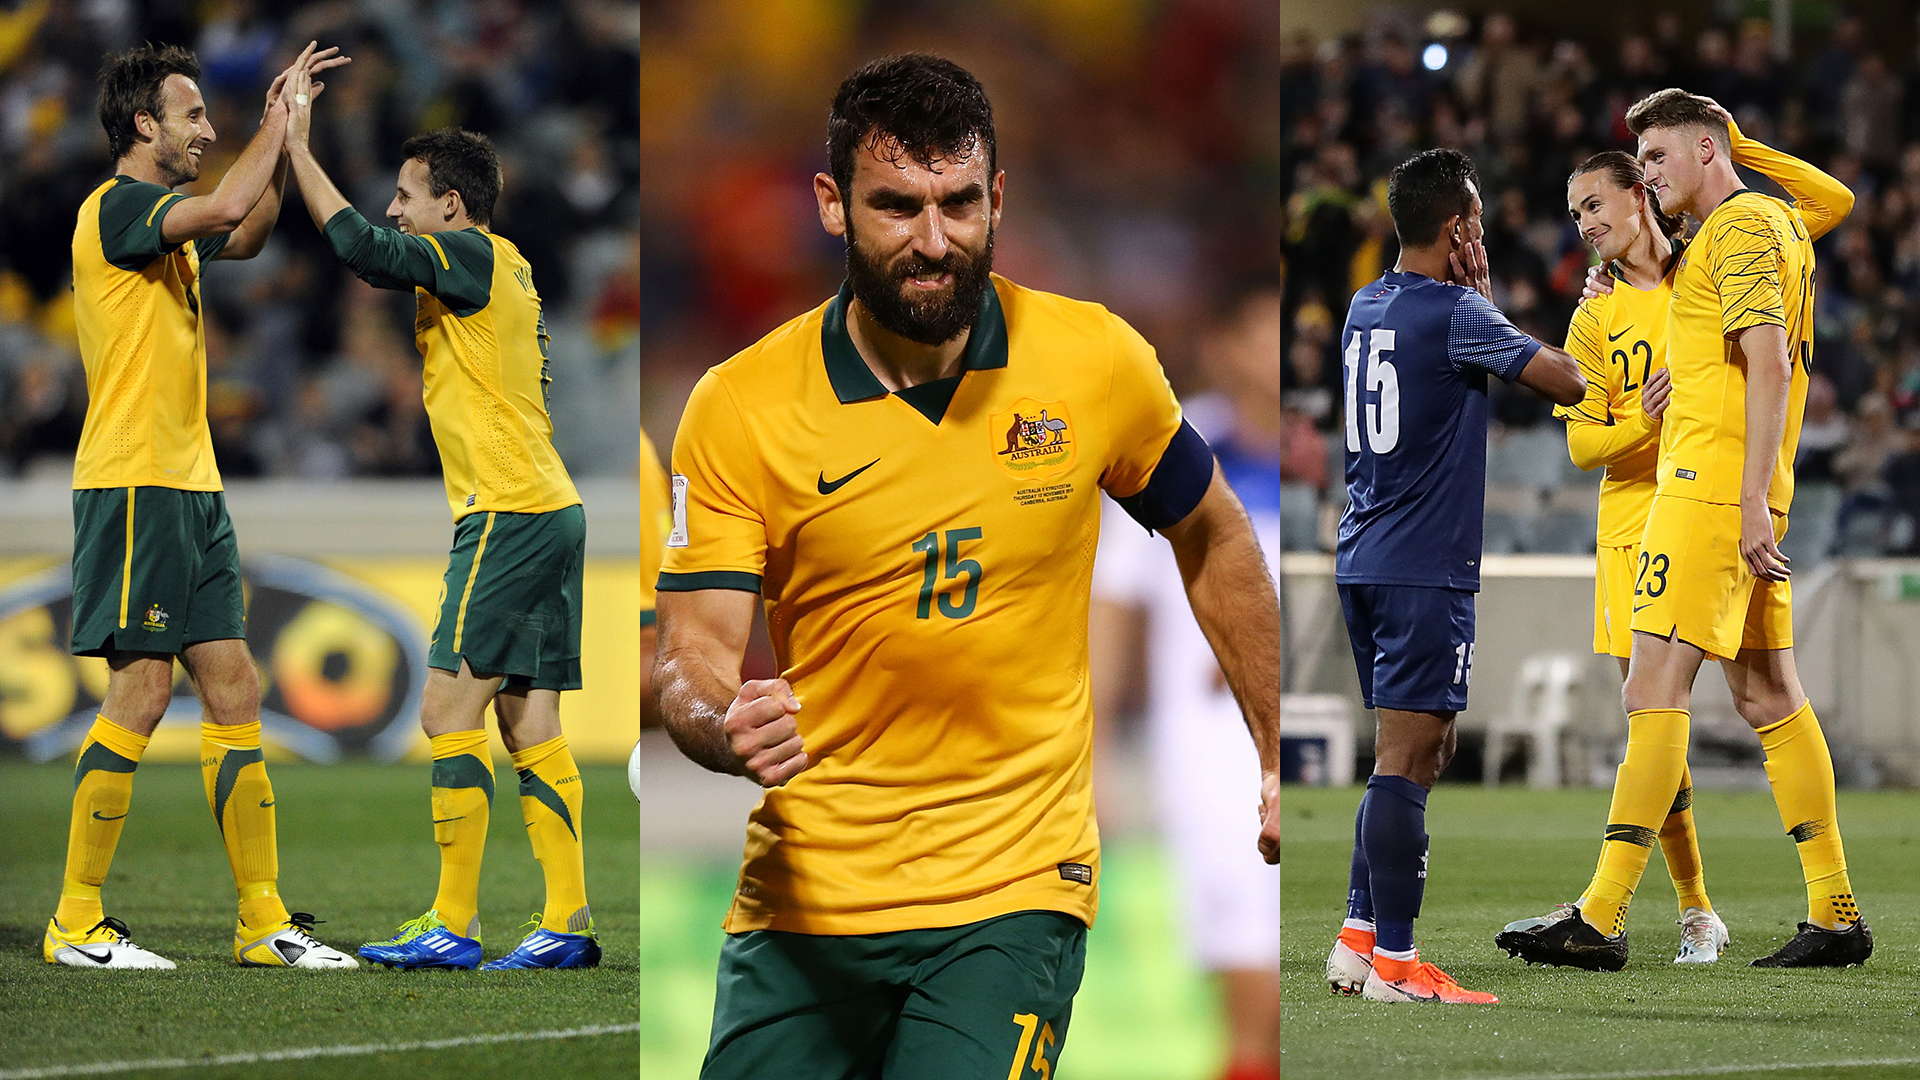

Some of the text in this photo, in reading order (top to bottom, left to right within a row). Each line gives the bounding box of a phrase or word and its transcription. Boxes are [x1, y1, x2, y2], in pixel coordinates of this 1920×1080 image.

[1345, 329, 1399, 454] 15
[1612, 340, 1652, 392] 22
[1011, 446, 1063, 460] AUSTRALIA
[912, 526, 982, 619] 15
[1634, 551, 1670, 598] 23
[1453, 642, 1475, 687] 15
[1007, 1012, 1055, 1080] 15
